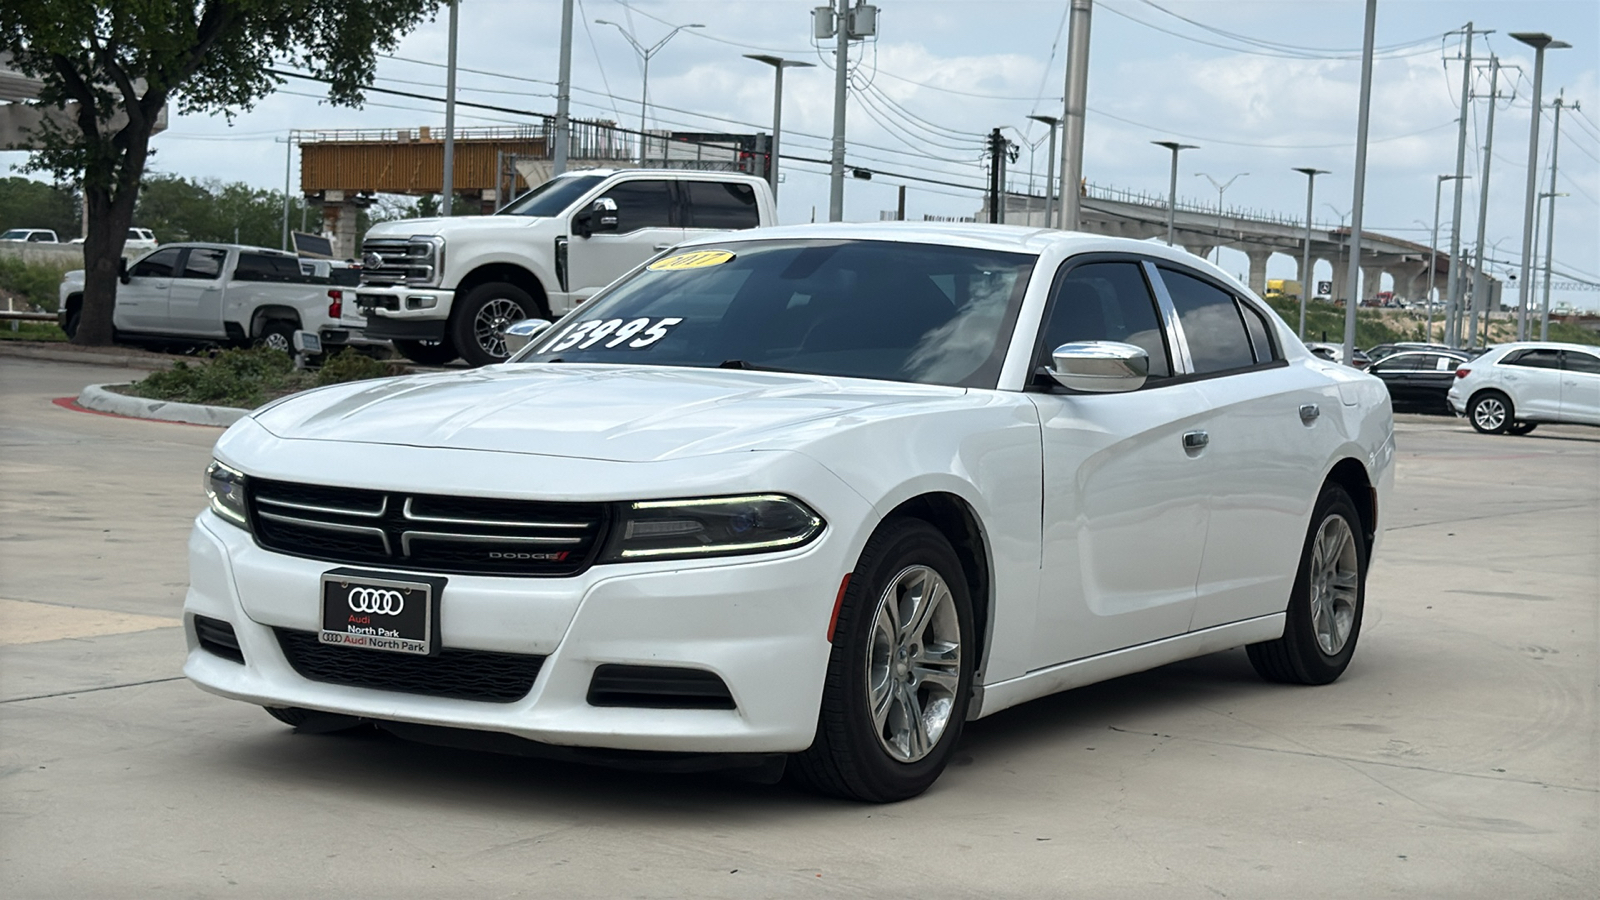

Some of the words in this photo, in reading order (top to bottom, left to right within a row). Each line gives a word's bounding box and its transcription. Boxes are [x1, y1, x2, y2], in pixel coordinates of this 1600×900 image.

[537, 317, 683, 354] 13995
[489, 552, 559, 560] DODGE
[348, 614, 370, 624] Audi
[347, 624, 376, 636] North
[378, 627, 399, 638] Park
[343, 635, 367, 645] Audi
[369, 639, 400, 650] North
[401, 643, 425, 652] Park
